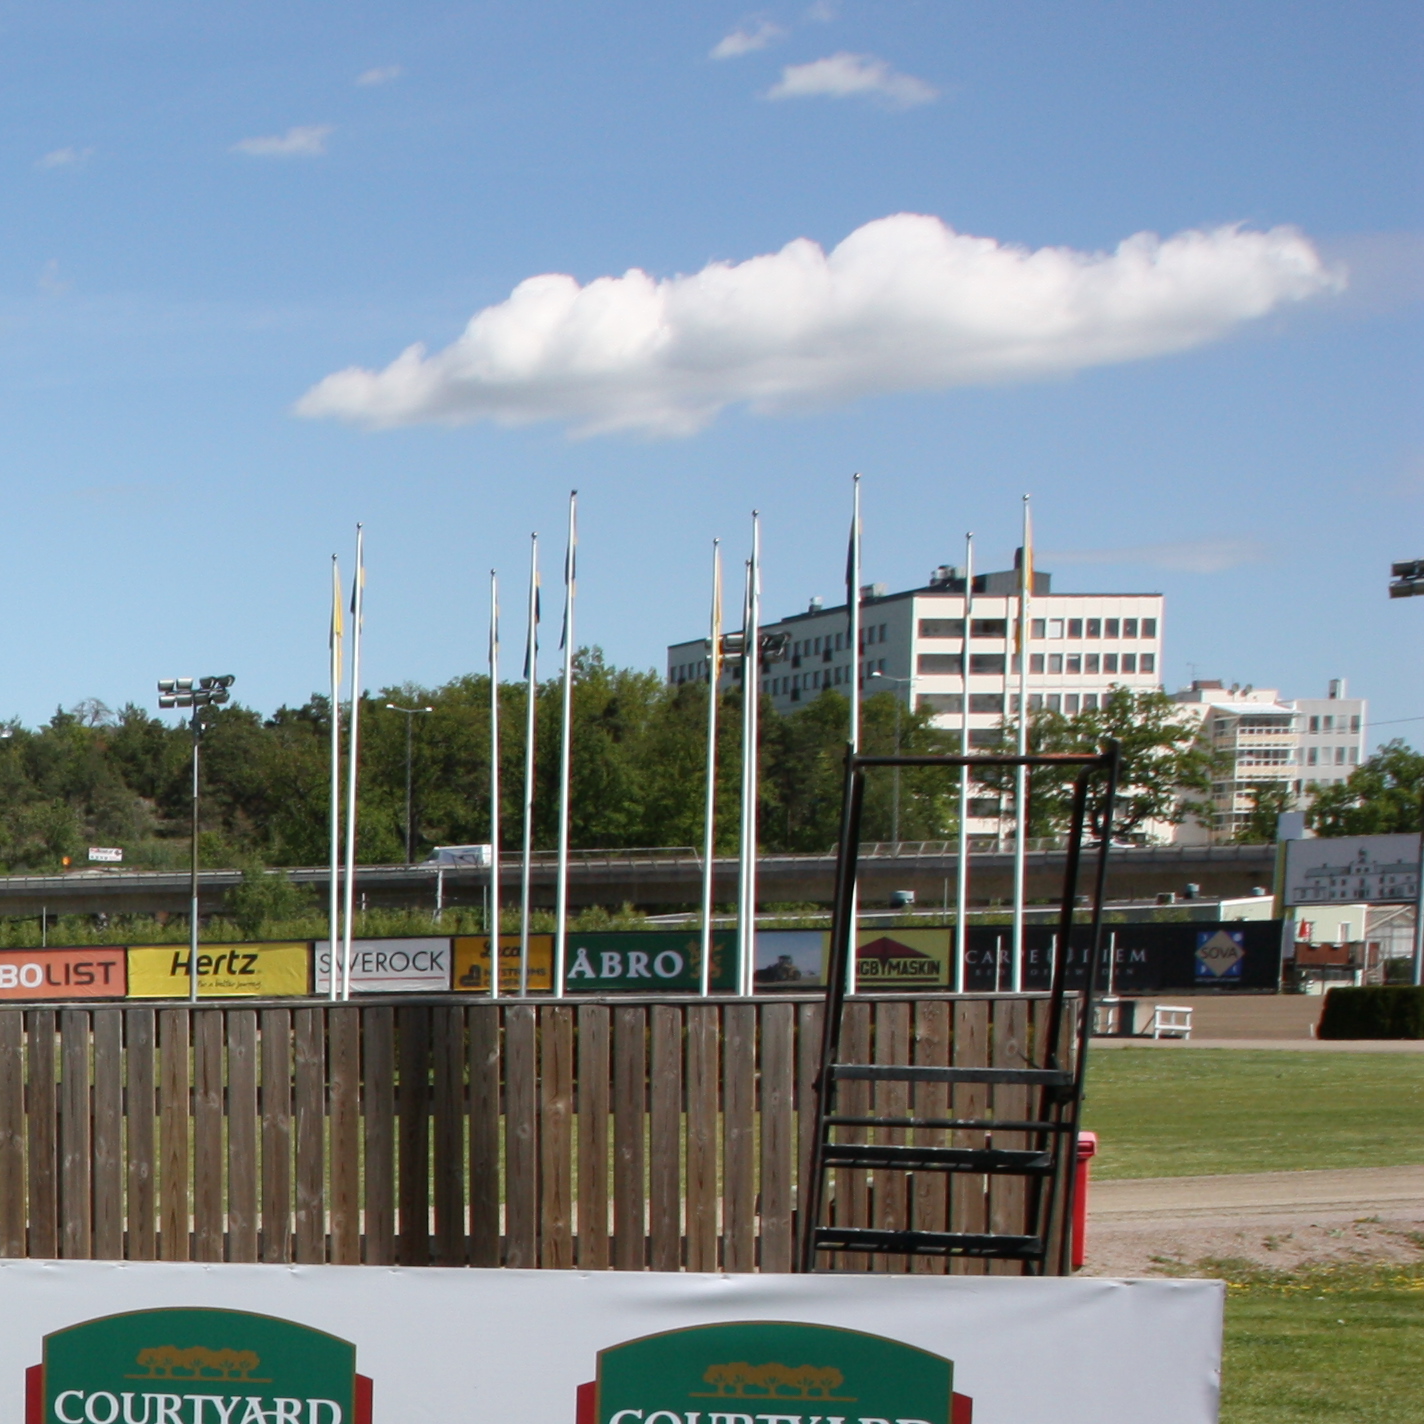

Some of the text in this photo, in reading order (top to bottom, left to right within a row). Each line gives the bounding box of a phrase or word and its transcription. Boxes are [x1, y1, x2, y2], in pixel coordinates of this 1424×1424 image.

[170, 949, 259, 977] Hertz
[567, 947, 684, 980] ÅBRO
[965, 949, 1039, 965] CARE
[1200, 947, 1238, 959] SOVA
